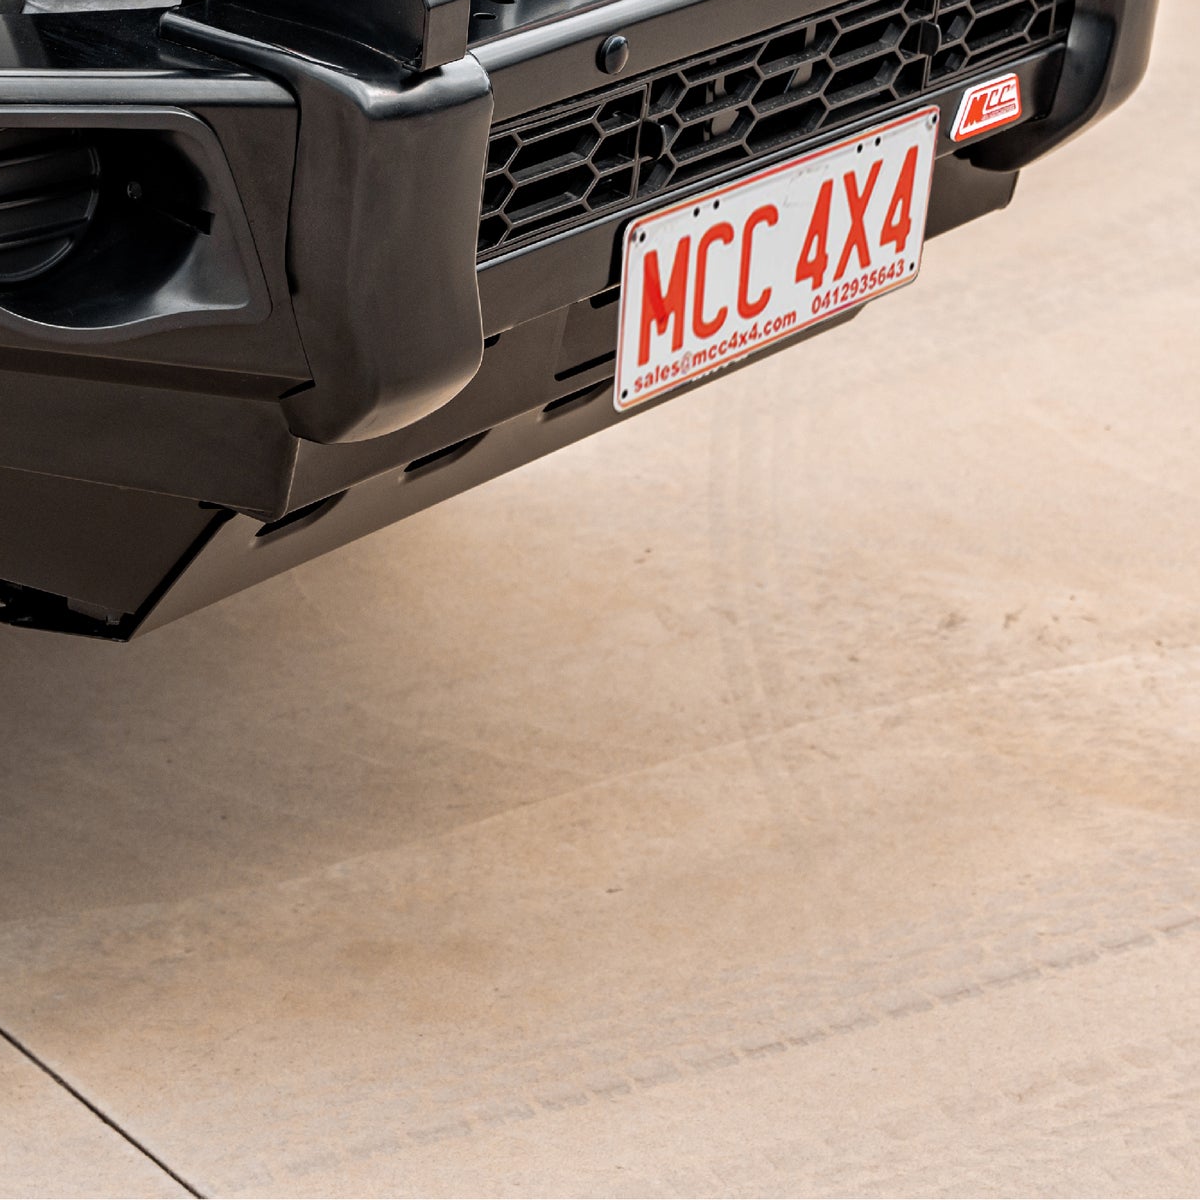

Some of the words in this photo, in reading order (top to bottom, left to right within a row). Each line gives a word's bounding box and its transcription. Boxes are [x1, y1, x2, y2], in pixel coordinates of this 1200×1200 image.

[963, 84, 1016, 129] MCC
[637, 204, 779, 367] MCC
[795, 145, 920, 291] 4X4
[633, 310, 797, 394] sales@mcc4x4.com
[812, 258, 905, 314] 0412935643
